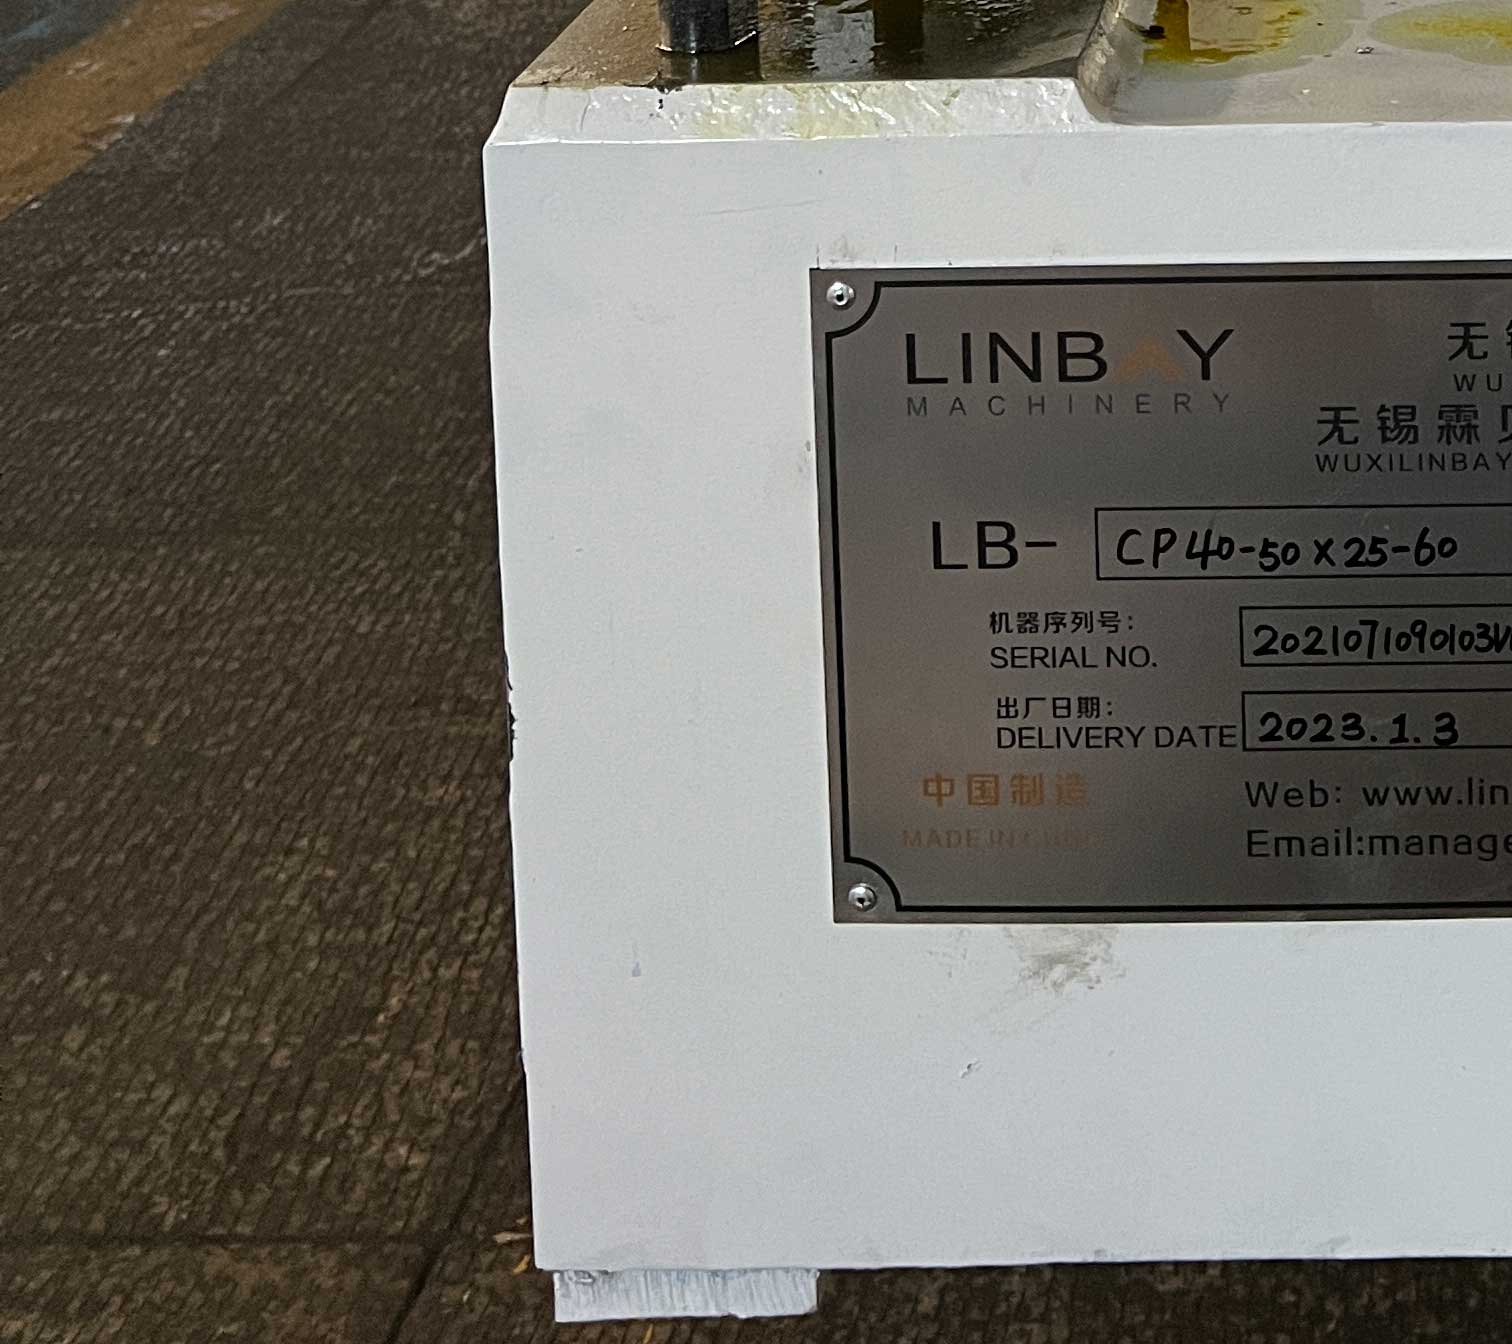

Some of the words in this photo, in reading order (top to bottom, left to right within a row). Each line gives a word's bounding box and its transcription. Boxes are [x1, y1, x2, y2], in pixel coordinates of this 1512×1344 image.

[905, 328, 1235, 384] LINBAY
[907, 393, 1229, 416] MACHINERY
[932, 521, 1057, 569] LB-
[990, 646, 1098, 669] SERIAL
[1106, 646, 1157, 668] NO.
[997, 726, 1144, 749] DELIVERY
[1155, 725, 1237, 748] DATE
[922, 773, 1089, 808] 中国制造
[1245, 779, 1341, 808] Web:
